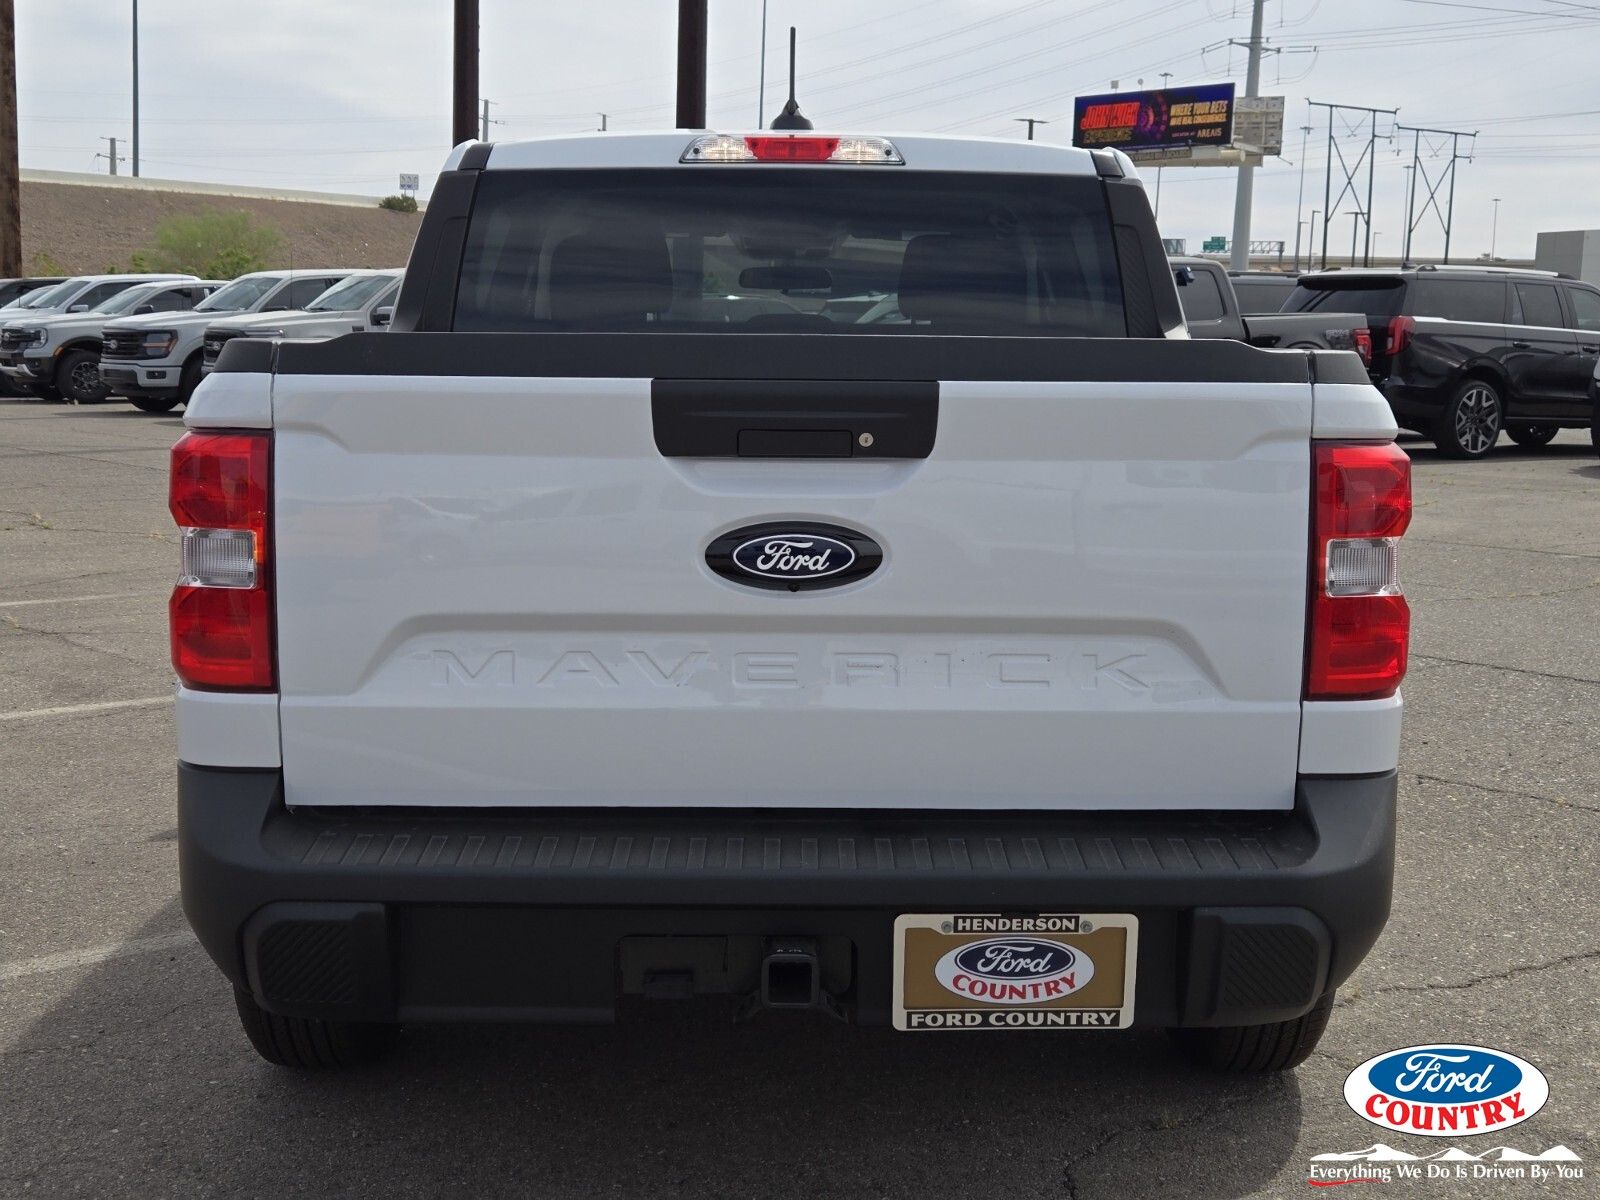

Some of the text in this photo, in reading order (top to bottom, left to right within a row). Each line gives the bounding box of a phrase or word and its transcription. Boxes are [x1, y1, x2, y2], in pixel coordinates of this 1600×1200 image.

[1210, 100, 1228, 113] BETS
[757, 541, 831, 570] Ford
[431, 650, 1151, 690] MAVERICK
[957, 918, 1075, 931] HENDERSON
[977, 945, 1053, 973] Ford
[952, 971, 1077, 1000] COUNTRY
[911, 1012, 1116, 1027] FORD COUNTRY
